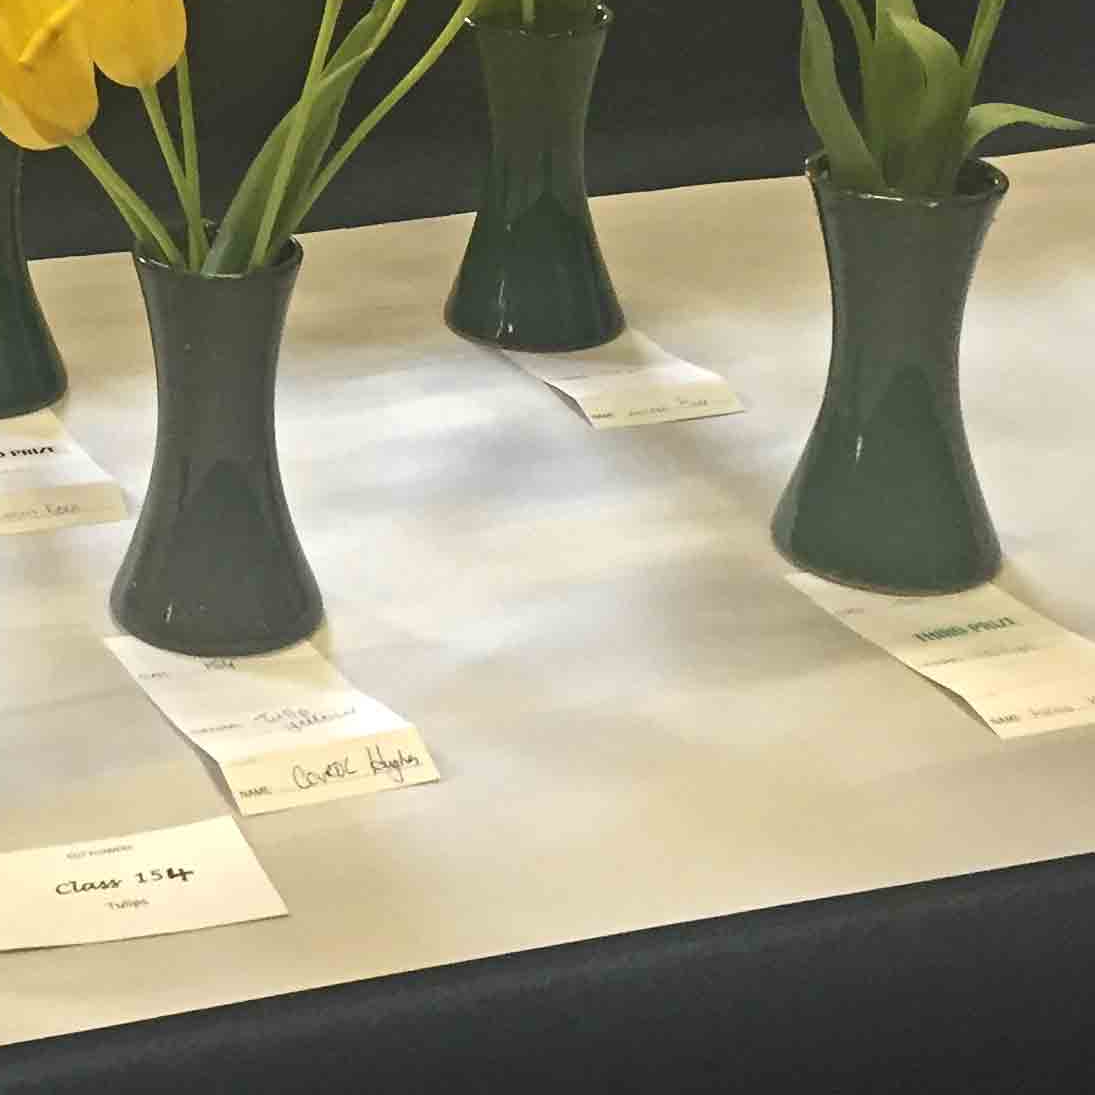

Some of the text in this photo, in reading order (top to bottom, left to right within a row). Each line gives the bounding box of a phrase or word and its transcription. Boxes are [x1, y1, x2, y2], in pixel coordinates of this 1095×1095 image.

[9, 445, 58, 458] PRIZE
[55, 867, 194, 896] Class 154
